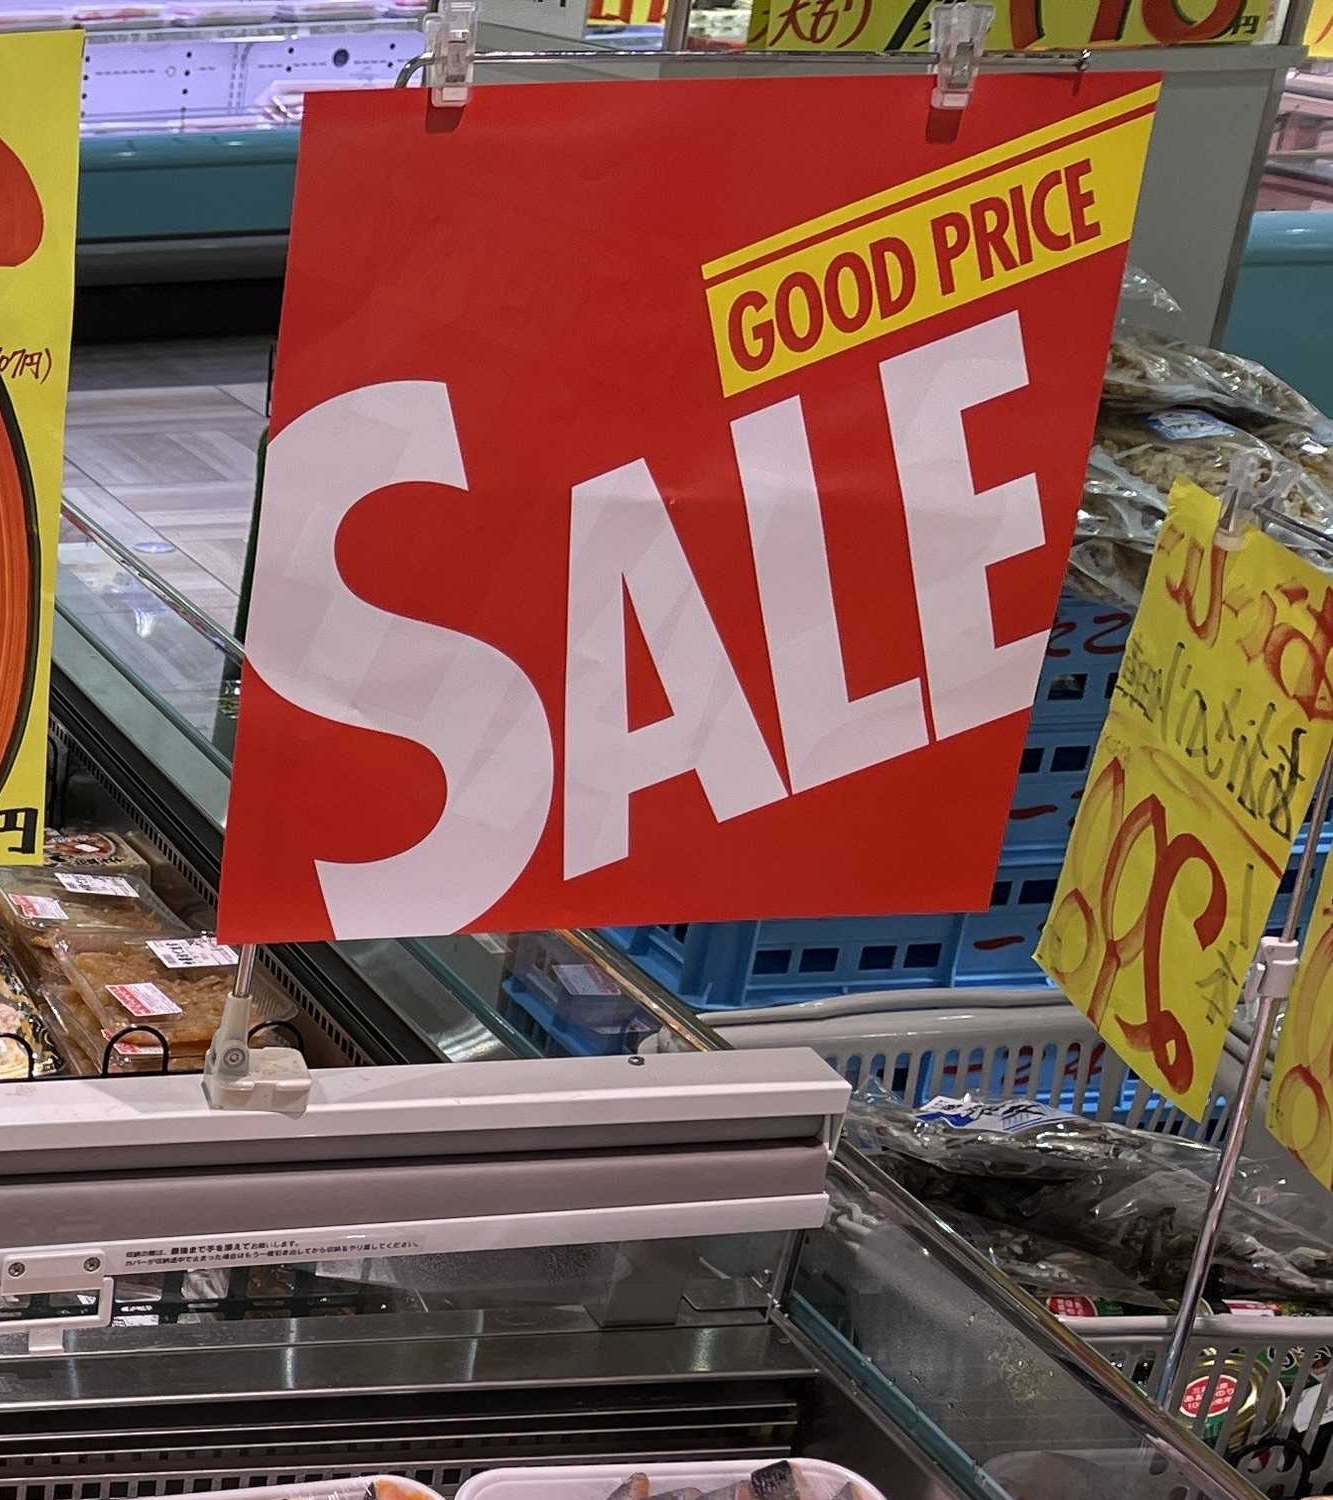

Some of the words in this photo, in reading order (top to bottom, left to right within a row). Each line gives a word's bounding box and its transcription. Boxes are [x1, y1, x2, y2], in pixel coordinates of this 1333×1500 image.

[727, 236, 917, 372] GOOD
[930, 158, 1102, 296] PRICE
[244, 309, 1051, 942] SALE
